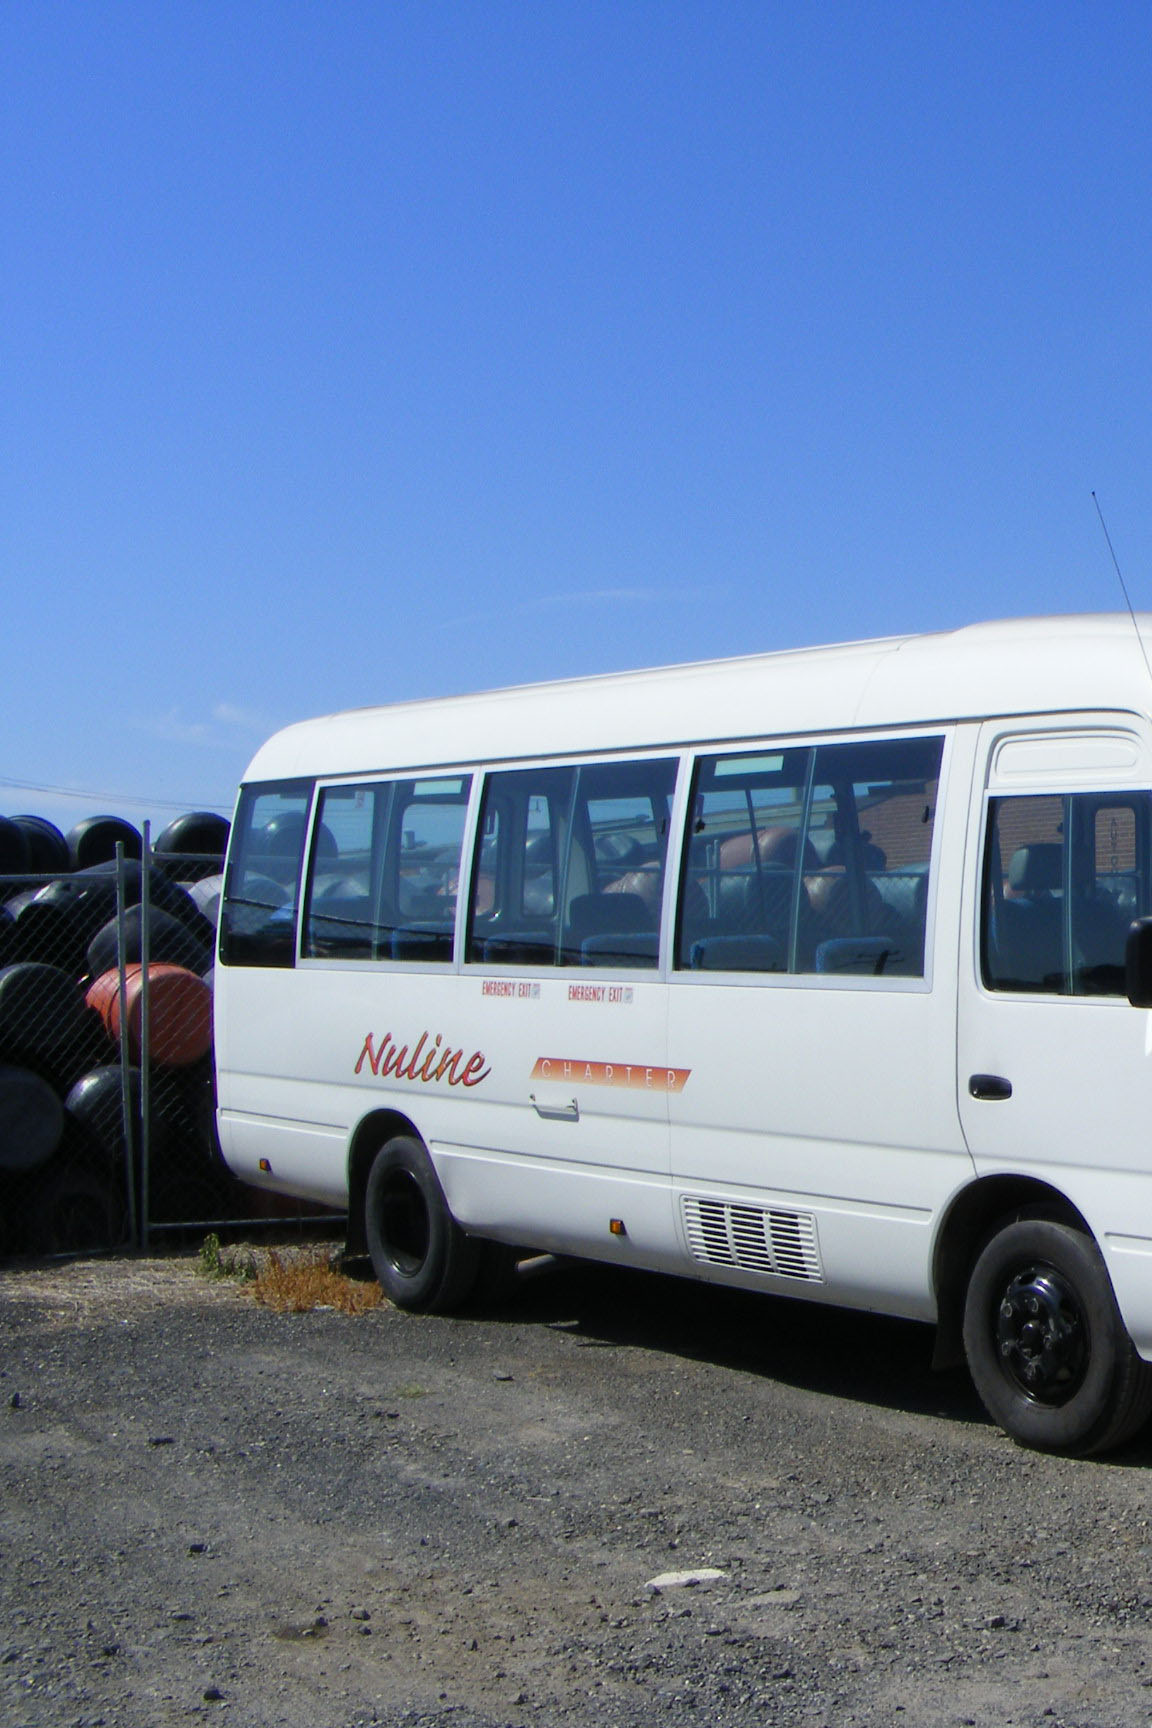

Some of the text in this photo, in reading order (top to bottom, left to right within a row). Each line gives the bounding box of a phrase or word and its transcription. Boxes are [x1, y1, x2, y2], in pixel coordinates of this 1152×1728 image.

[482, 981, 531, 998] EMERGENCY EXIT
[568, 985, 623, 1002] EMERGENCY EXIT
[354, 1030, 491, 1087] Nuline
[541, 1060, 676, 1088] CHARTER
